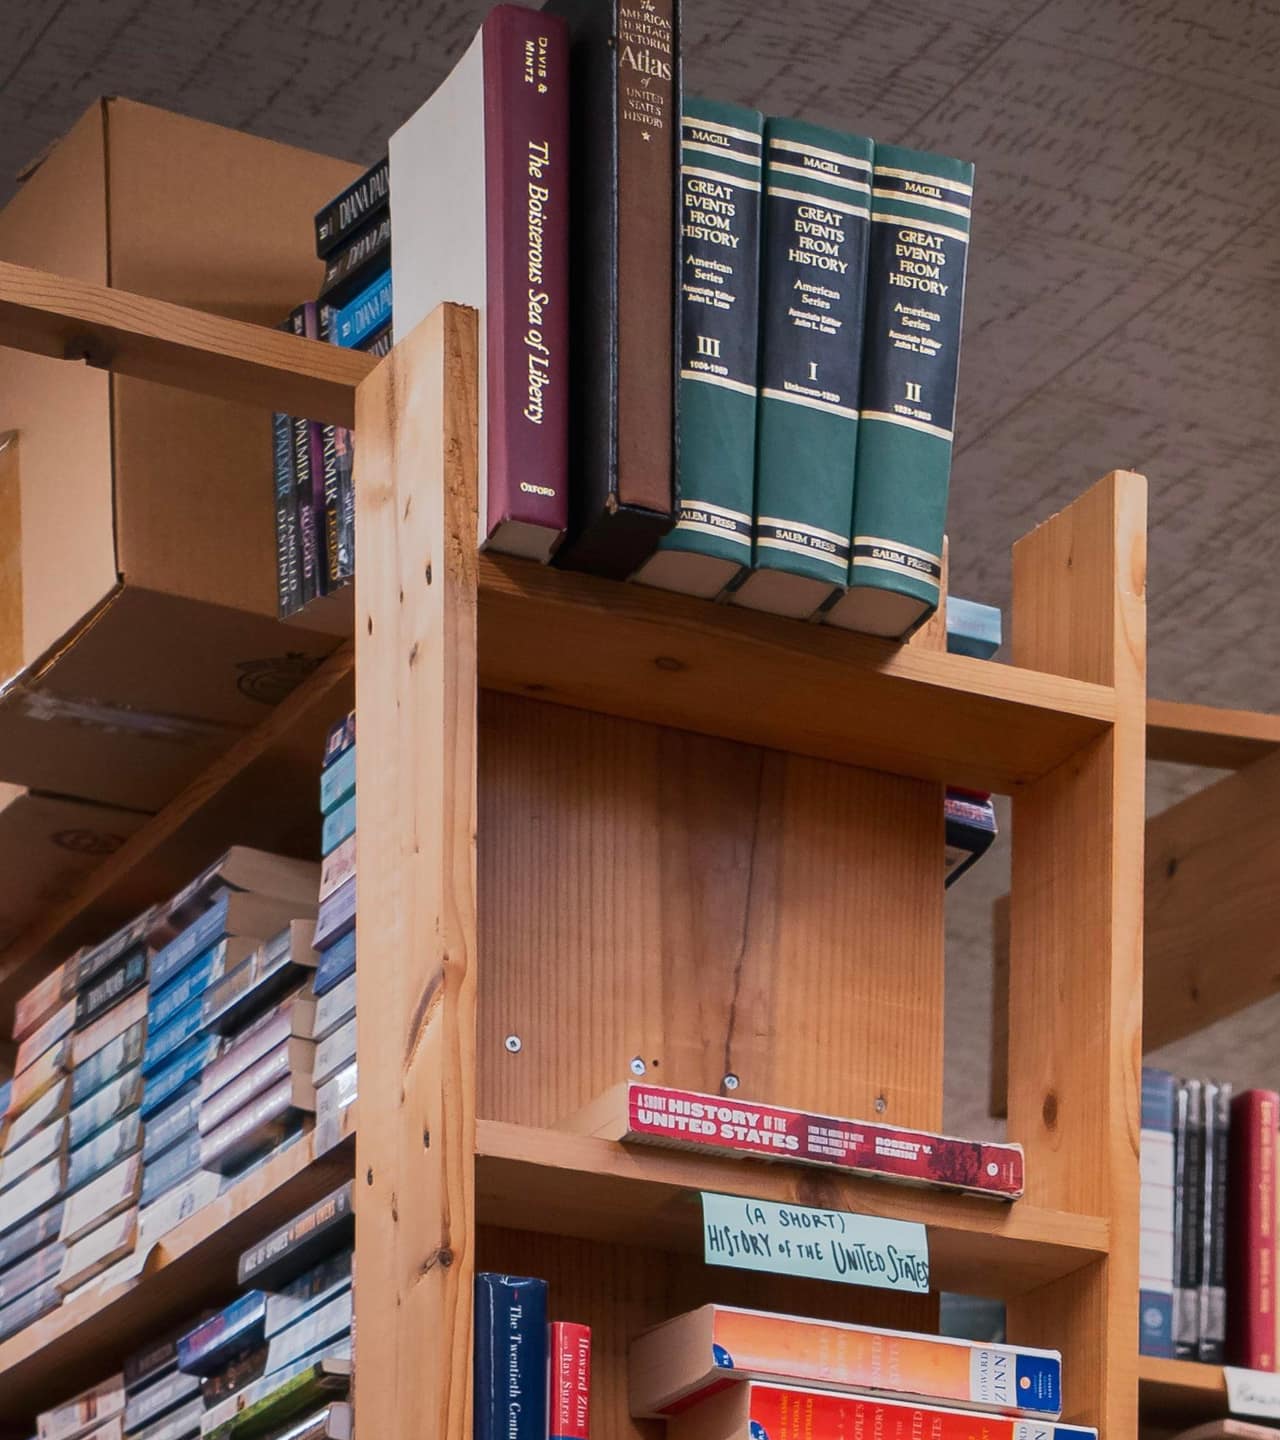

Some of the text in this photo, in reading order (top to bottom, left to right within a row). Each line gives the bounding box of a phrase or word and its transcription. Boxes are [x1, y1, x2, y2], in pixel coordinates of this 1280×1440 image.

[525, 40, 535, 83] MINTZ
[537, 36, 548, 94] DAVIS &
[619, 46, 671, 81] Atlas
[641, 77, 651, 88] of
[692, 130, 730, 147] MAGILL
[803, 156, 841, 175] MAGILL
[687, 180, 733, 200] GREAT
[905, 181, 942, 199] MAGILL
[685, 194, 736, 216] EVENTS
[797, 206, 842, 227] GREAT
[690, 212, 730, 231] FROM
[794, 220, 845, 243] EVENTS
[682, 225, 739, 249] HISTORY
[799, 236, 839, 257] FROM
[898, 230, 944, 249] GREAT
[788, 248, 849, 275] HISTORY
[895, 244, 946, 266] EVENTS
[900, 258, 939, 279] FROM
[523, 140, 550, 425] The Boisterous Sea of Liberty
[889, 272, 949, 297] HISTORY
[520, 481, 555, 497] OXFORD
[644, 1095, 665, 1112] SHORT
[668, 1098, 759, 1128] HISTORY
[637, 1110, 717, 1137] UNITED
[720, 1123, 800, 1151] STATES
[745, 1204, 846, 1232] (A SHORT)
[707, 1224, 774, 1257] HISTORY
[797, 1241, 823, 1261] THE
[831, 1240, 886, 1275] UNITED
[510, 1305, 522, 1330] The
[510, 1335, 522, 1397] Twentieth
